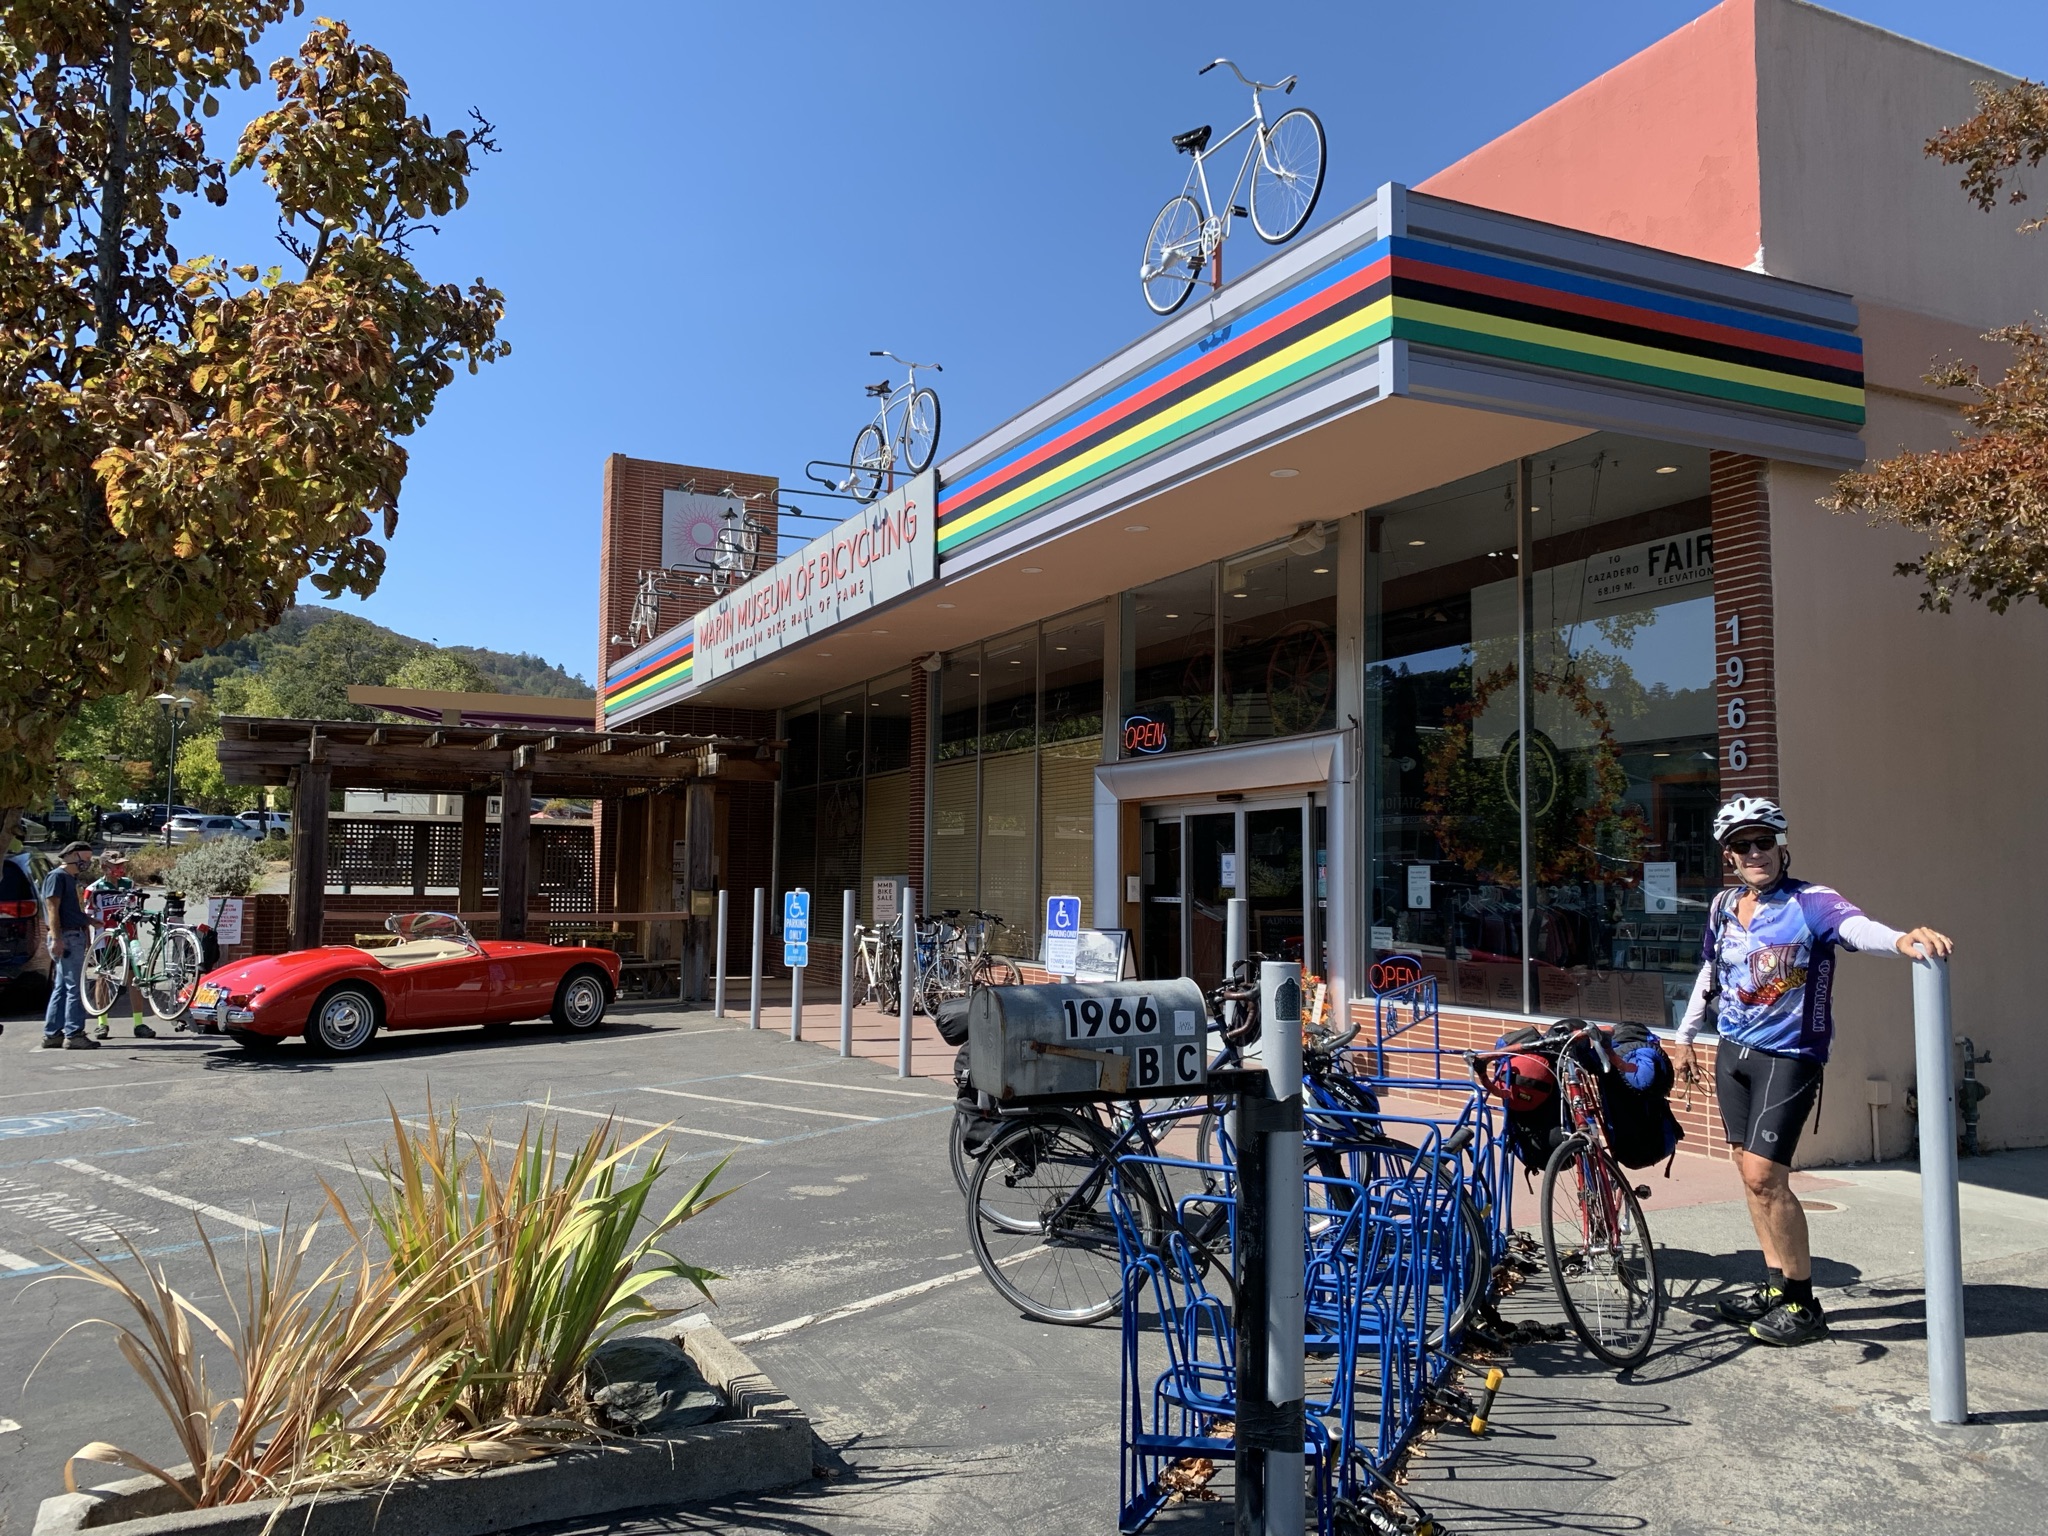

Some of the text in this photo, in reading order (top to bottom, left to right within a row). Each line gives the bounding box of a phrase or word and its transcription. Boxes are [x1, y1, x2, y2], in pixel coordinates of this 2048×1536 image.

[1608, 554, 1621, 565] TO
[700, 500, 917, 653] MARIN MUSEUM OF BICYCLING
[1587, 565, 1639, 584] CAZADERO
[1657, 567, 1714, 586] ELEVATION
[725, 579, 864, 659] MOUNTAIN BIKE HALL OF FAME
[1725, 614, 1748, 772] 1966
[1125, 722, 1165, 750] OPEN
[786, 918, 807, 929] PARKING
[789, 930, 803, 940] ONLY
[1369, 963, 1421, 993] OPEN
[1064, 996, 1157, 1038] 1966
